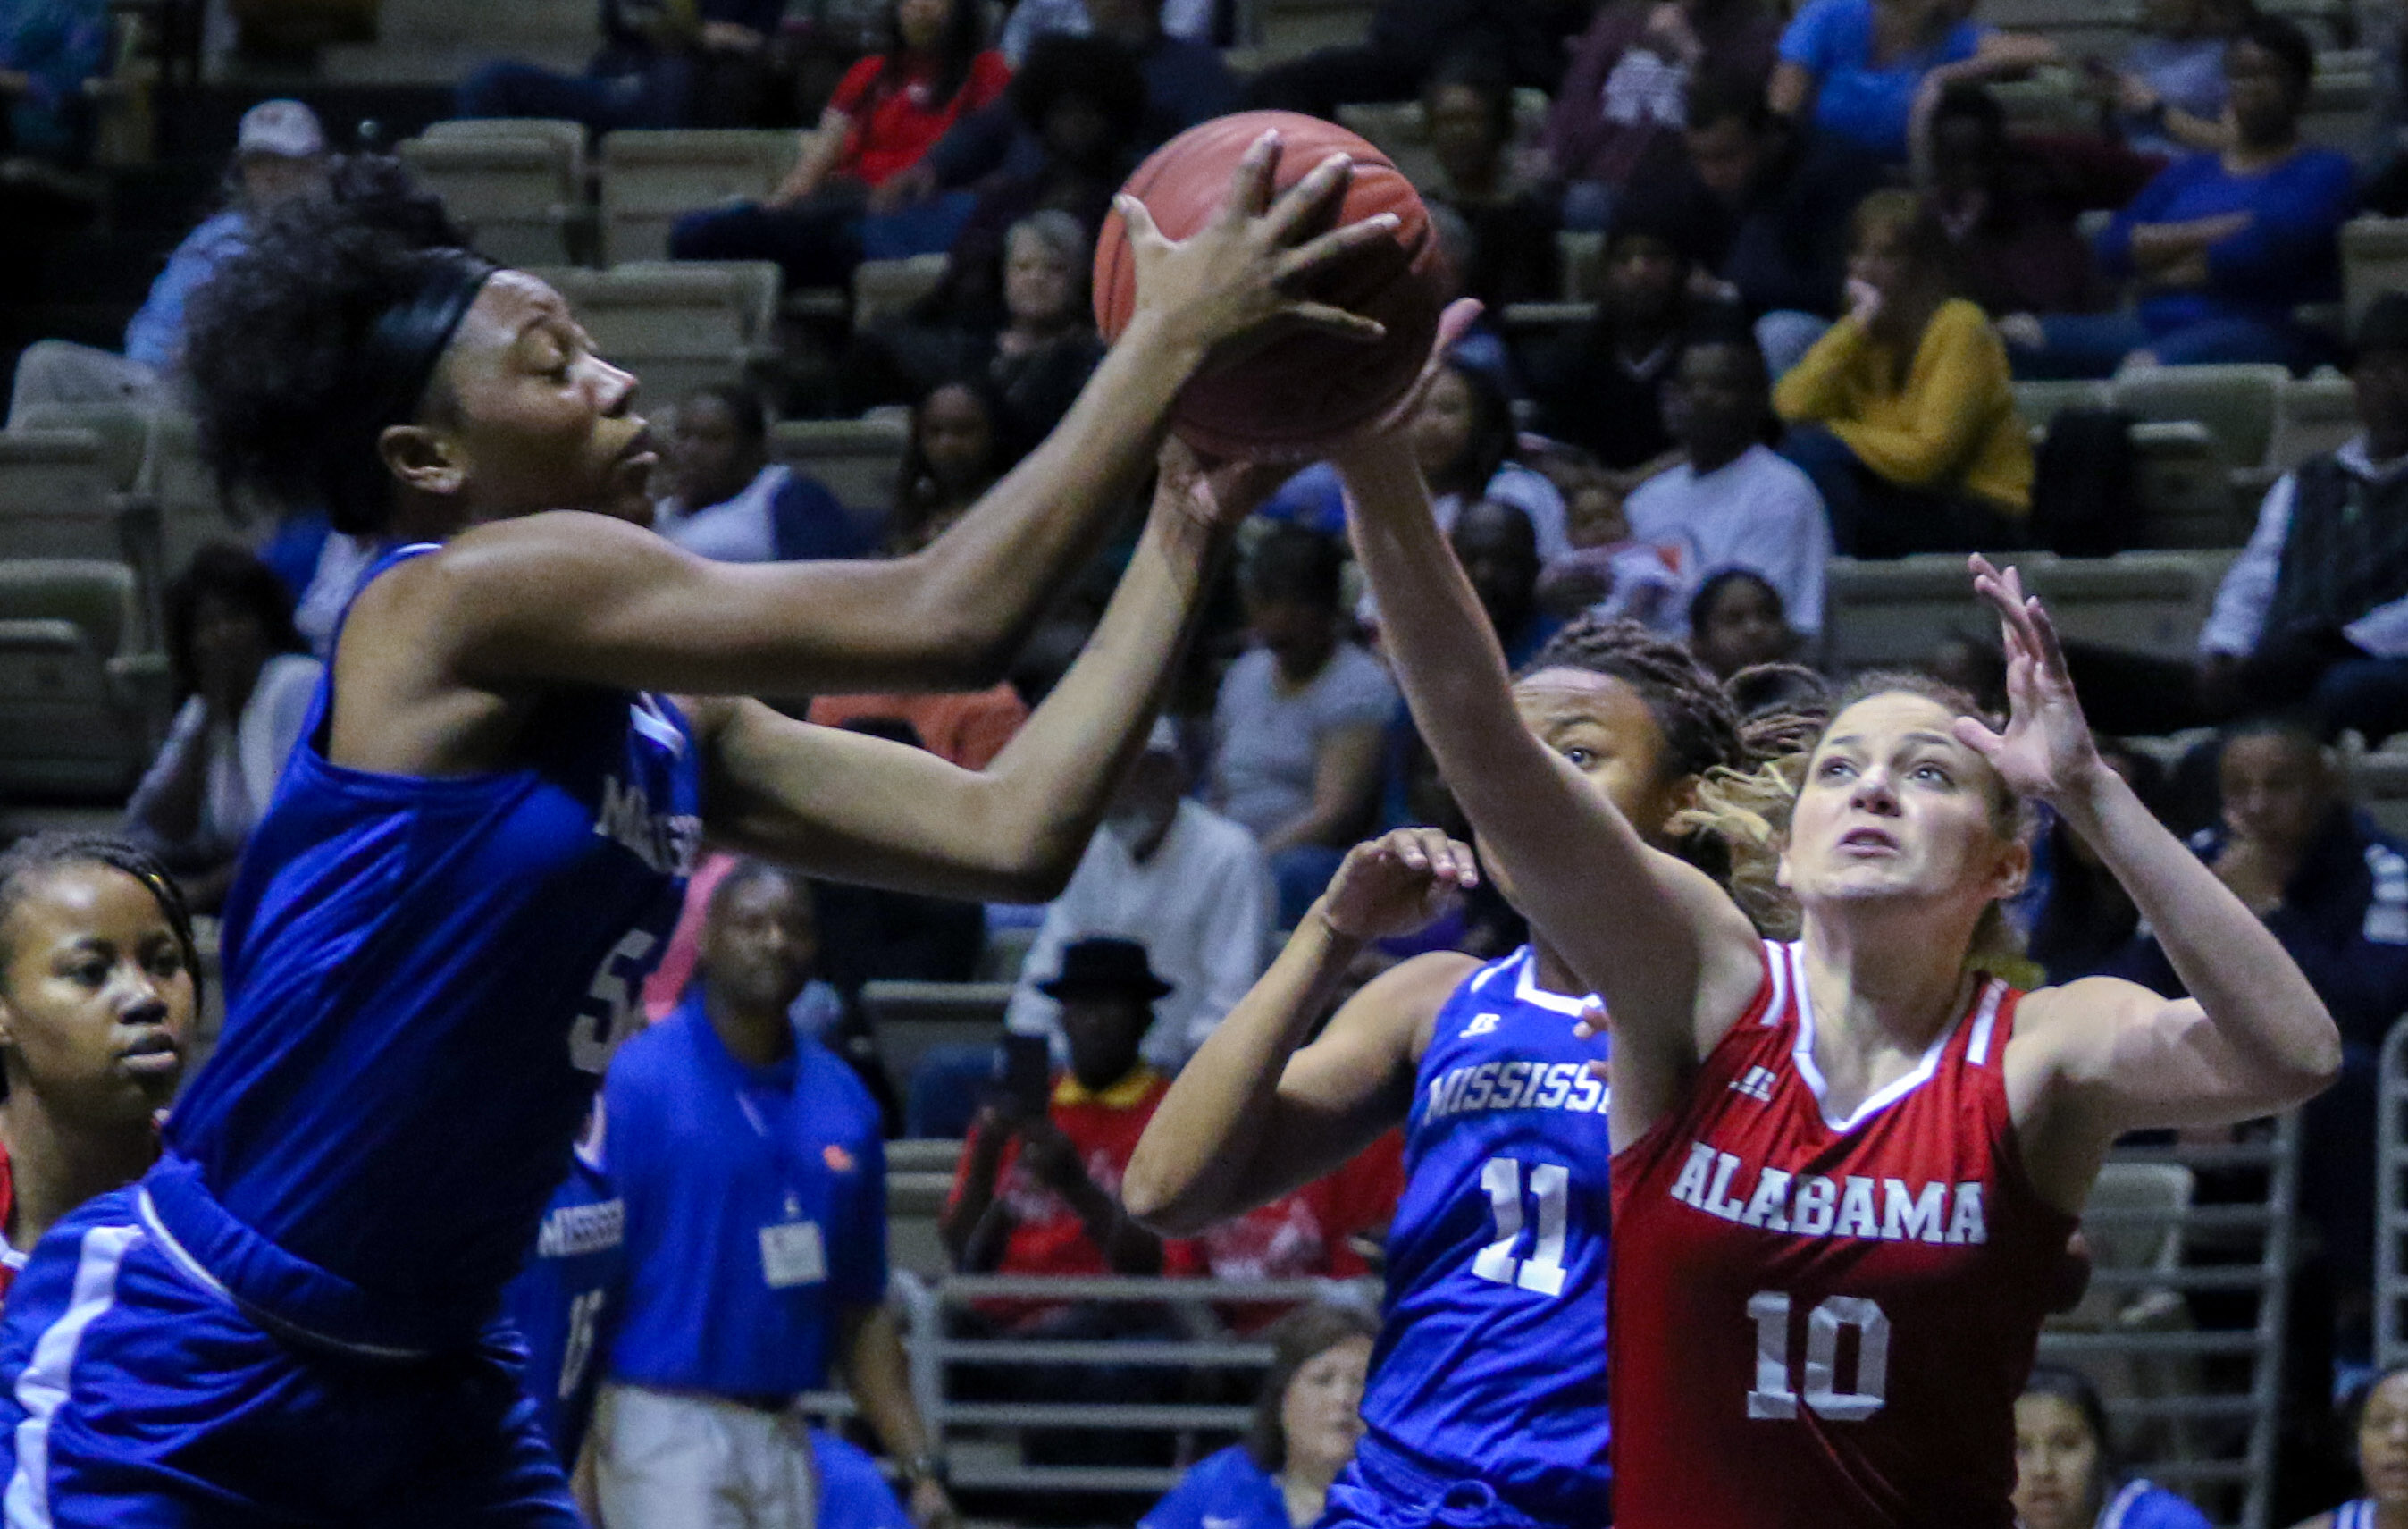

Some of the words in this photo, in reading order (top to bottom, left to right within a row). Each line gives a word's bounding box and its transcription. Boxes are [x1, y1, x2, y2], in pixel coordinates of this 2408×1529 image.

[1471, 1156, 1570, 1297] 11
[1670, 1141, 1988, 1244] ALABAMA
[1747, 1290, 1892, 1422] 10
